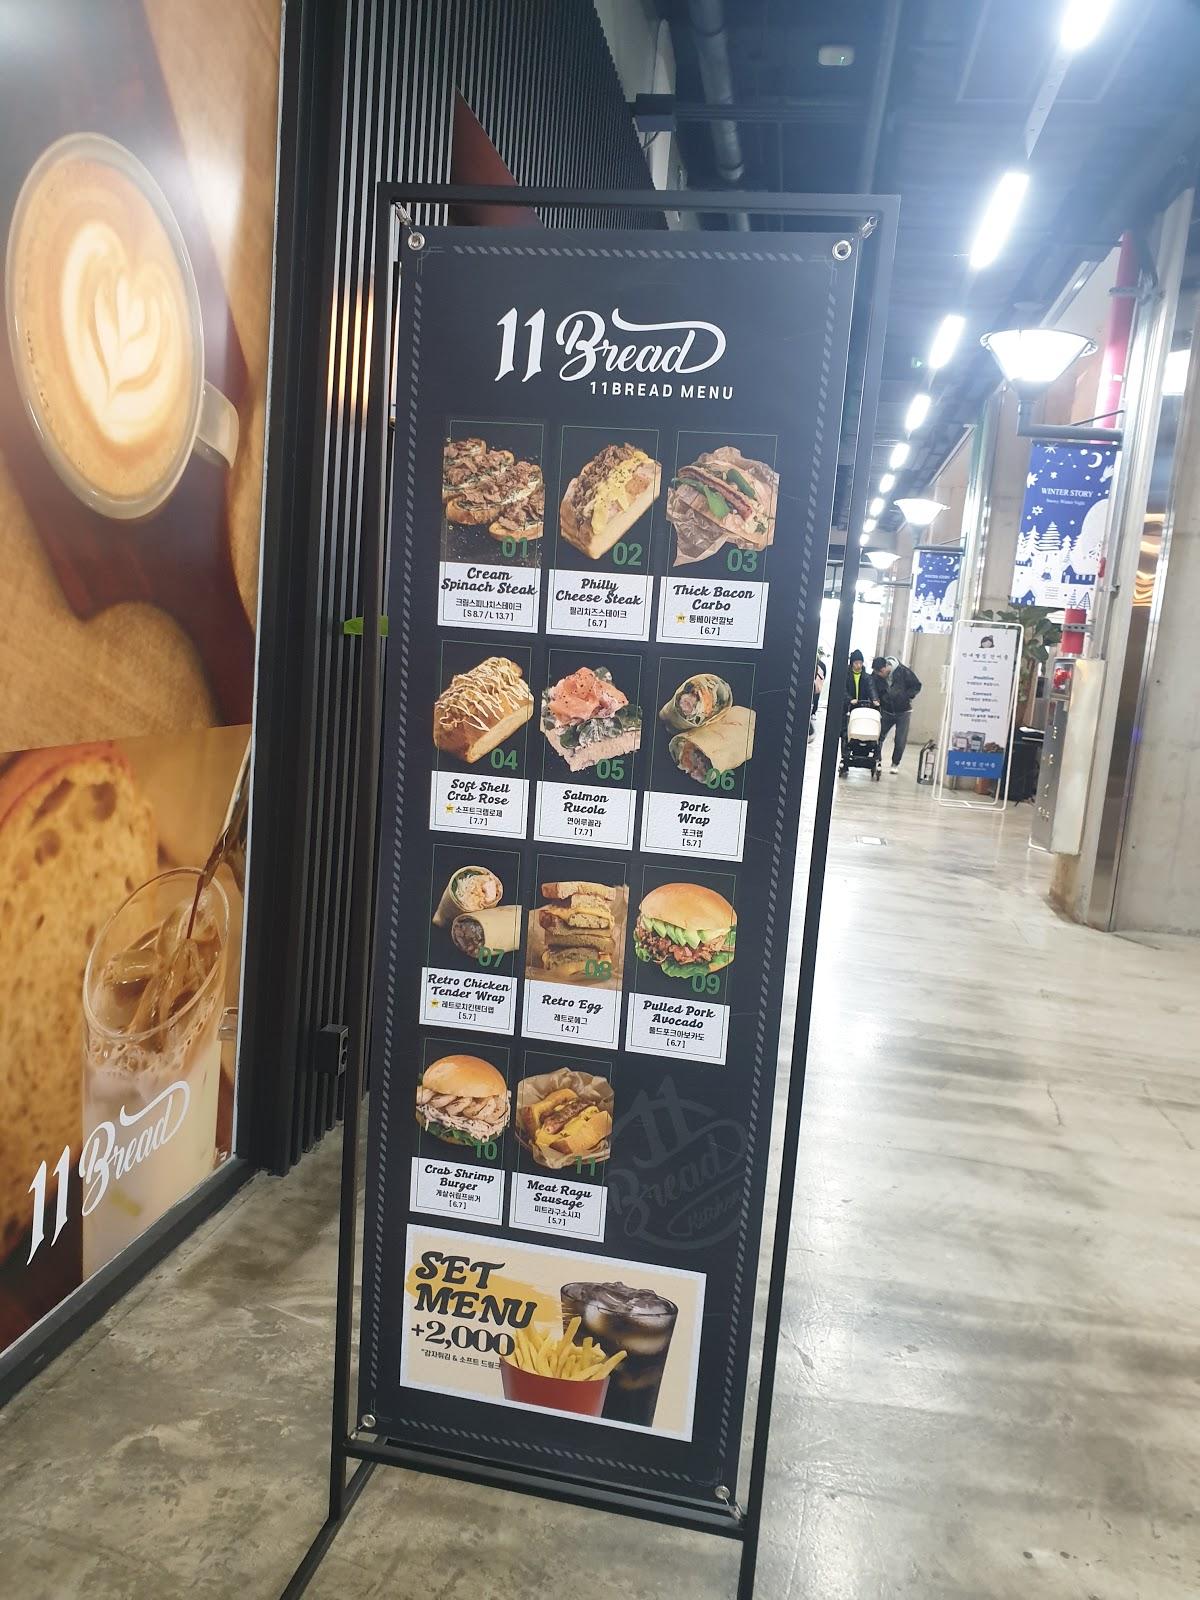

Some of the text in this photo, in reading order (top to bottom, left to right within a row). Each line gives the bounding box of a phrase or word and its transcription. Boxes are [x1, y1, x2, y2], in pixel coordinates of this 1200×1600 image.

[495, 307, 727, 382] 11 Bread
[590, 381, 733, 400] 11BREAD MENU
[1041, 487, 1094, 498] WINTER STORY
[501, 535, 529, 558] 01
[612, 542, 642, 567] 02
[726, 549, 757, 573] 03
[466, 567, 512, 581] Cream
[441, 578, 538, 596] Spinach Steak
[581, 578, 618, 594] Philly
[673, 584, 755, 599] Thick Bacon
[555, 590, 643, 606] Cheese Steak
[692, 598, 731, 611] Carbo
[570, 606, 627, 619] 필리치즈스테이크
[490, 748, 518, 770] 04
[596, 759, 625, 780] 05
[451, 779, 510, 793] Soft Shell
[705, 768, 735, 790] 06
[447, 791, 510, 805] Crab Rose
[562, 790, 609, 803] Salmon
[563, 802, 607, 815] Rucola
[679, 800, 710, 813] Pork
[567, 817, 602, 828] 연어루꼴라
[677, 813, 710, 827] Wrap
[682, 828, 703, 838] 포크랩
[477, 947, 505, 968] 07
[584, 958, 612, 981] 08
[428, 973, 511, 992] Retro Chicken
[691, 972, 721, 995] 09
[431, 986, 505, 1004] Tender Wrap
[542, 994, 603, 1014] Retro Egg
[642, 1000, 716, 1018] Pulled Pork
[651, 1013, 704, 1029] Avocado
[474, 1140, 498, 1160] 10
[26, 1080, 190, 1266] 11 Bread
[424, 1164, 495, 1184] Crab Shrimp
[575, 1155, 596, 1177] 11
[439, 1177, 479, 1192] Burger
[527, 1179, 592, 1199] Meat Ragu
[533, 1192, 585, 1210] Sausage
[534, 1206, 581, 1220] 미트라구소시지
[415, 1250, 506, 1289] SET
[414, 1282, 538, 1329] MENU
[411, 1320, 516, 1357] +2,000
[459, 1356, 479, 1366] 소프트
